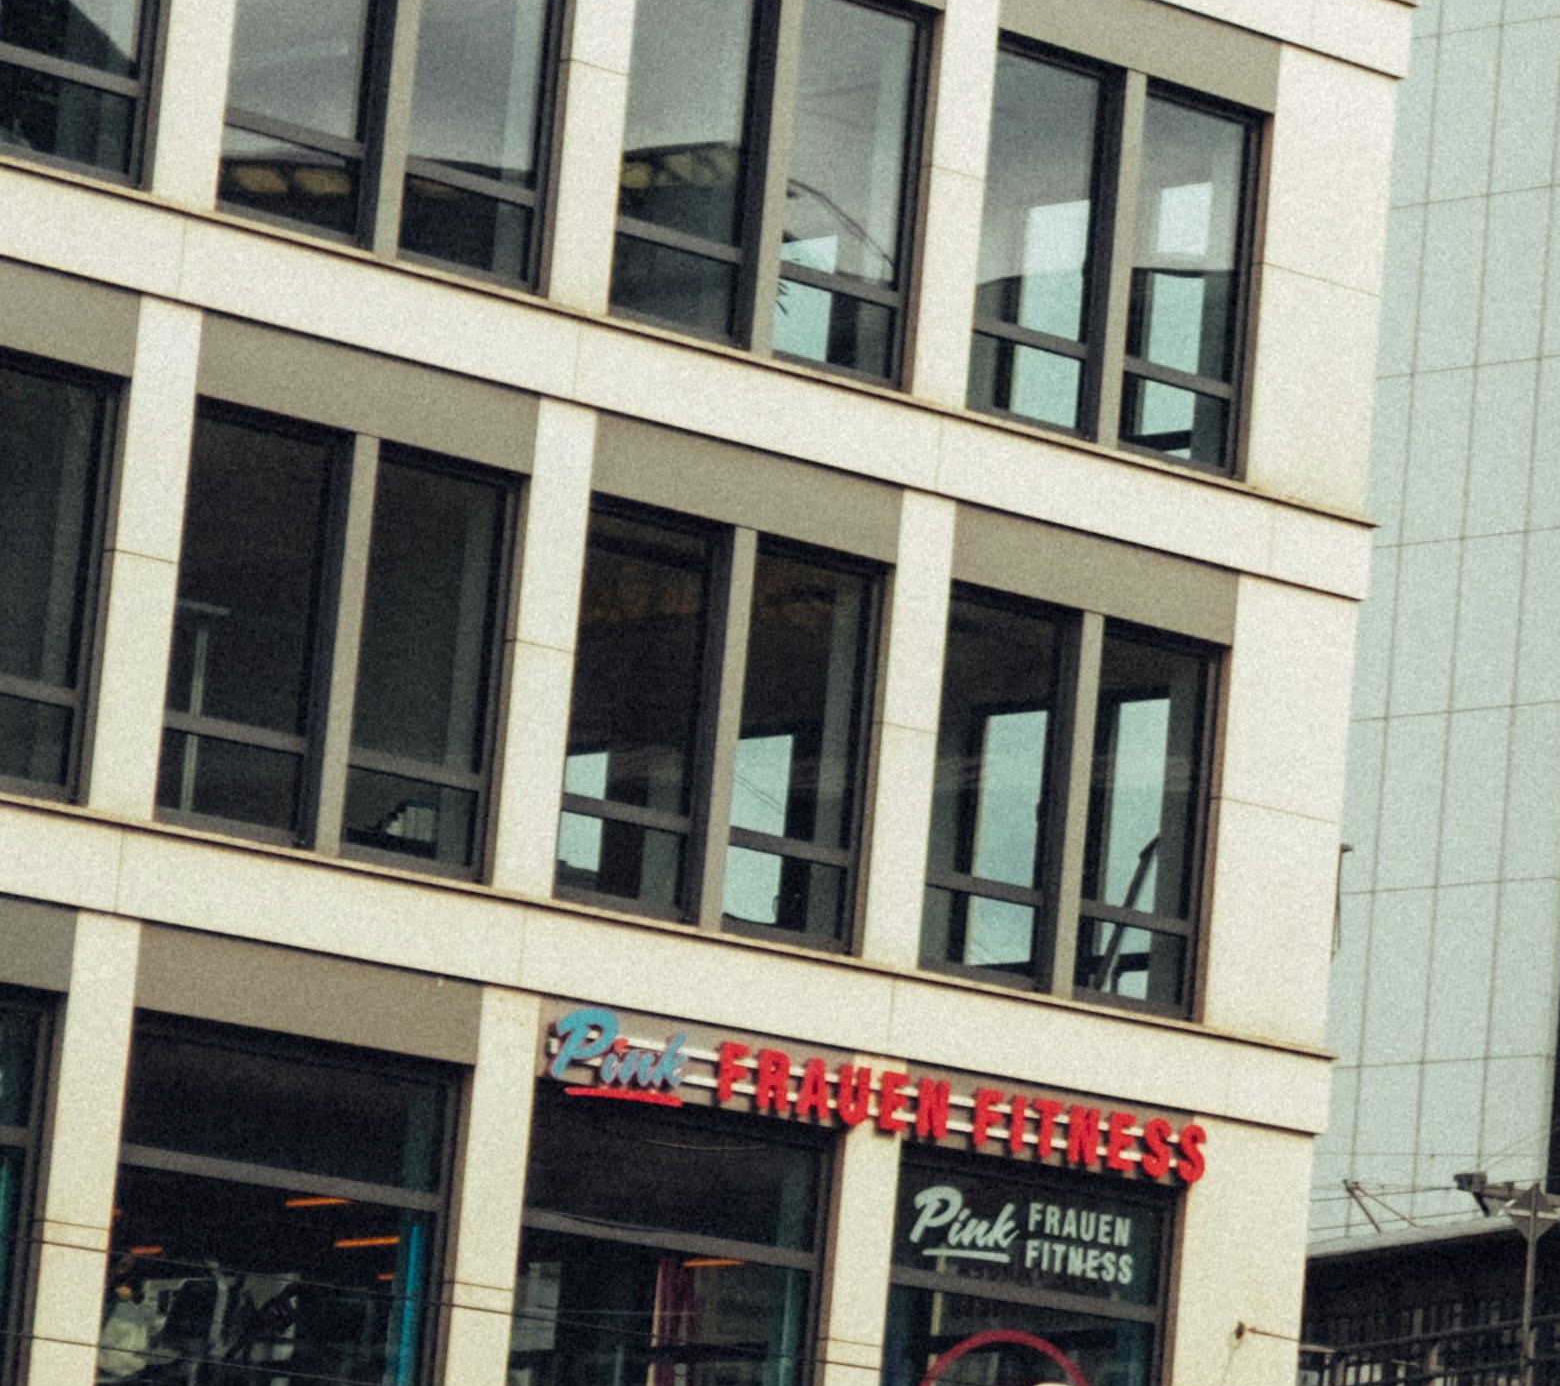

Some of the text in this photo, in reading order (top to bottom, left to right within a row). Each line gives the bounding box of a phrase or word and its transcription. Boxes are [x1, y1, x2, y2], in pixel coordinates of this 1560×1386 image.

[552, 1007, 1208, 1185] Pink FRAUEN FITNESS
[910, 1186, 1132, 1248] Pink FRAUEN
[1025, 1240, 1134, 1286] FITNESS
